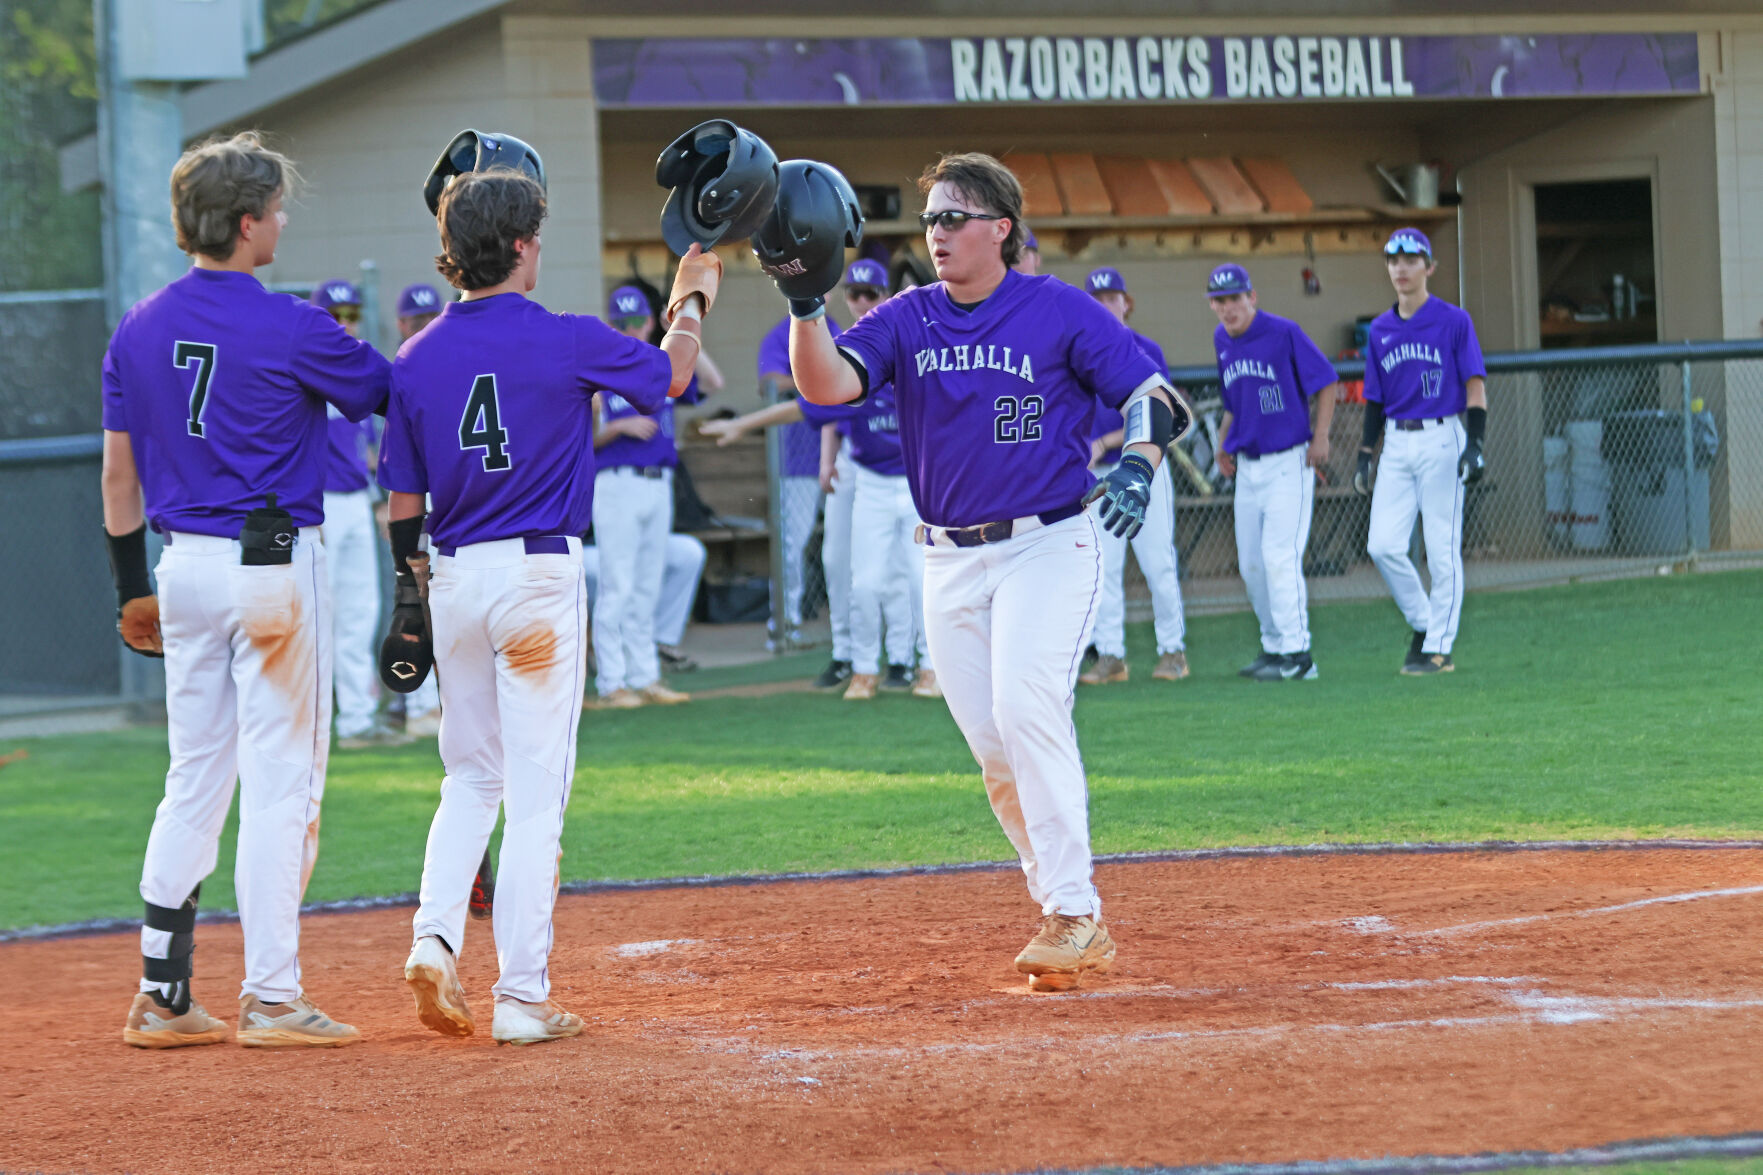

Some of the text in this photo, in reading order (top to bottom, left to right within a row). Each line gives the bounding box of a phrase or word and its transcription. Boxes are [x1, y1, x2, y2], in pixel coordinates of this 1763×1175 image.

[950, 36, 1415, 101] RAZORBACKS BASEBALL
[852, 266, 875, 283] W
[1091, 272, 1112, 289] W
[326, 285, 352, 303] W
[411, 289, 434, 306] W
[616, 295, 641, 313] W
[1381, 342, 1441, 374] WALHALLA
[173, 340, 218, 439] 7
[1258, 383, 1285, 415] 21
[1421, 368, 1442, 399] 17
[458, 373, 512, 472] 4
[994, 395, 1044, 443] 22
